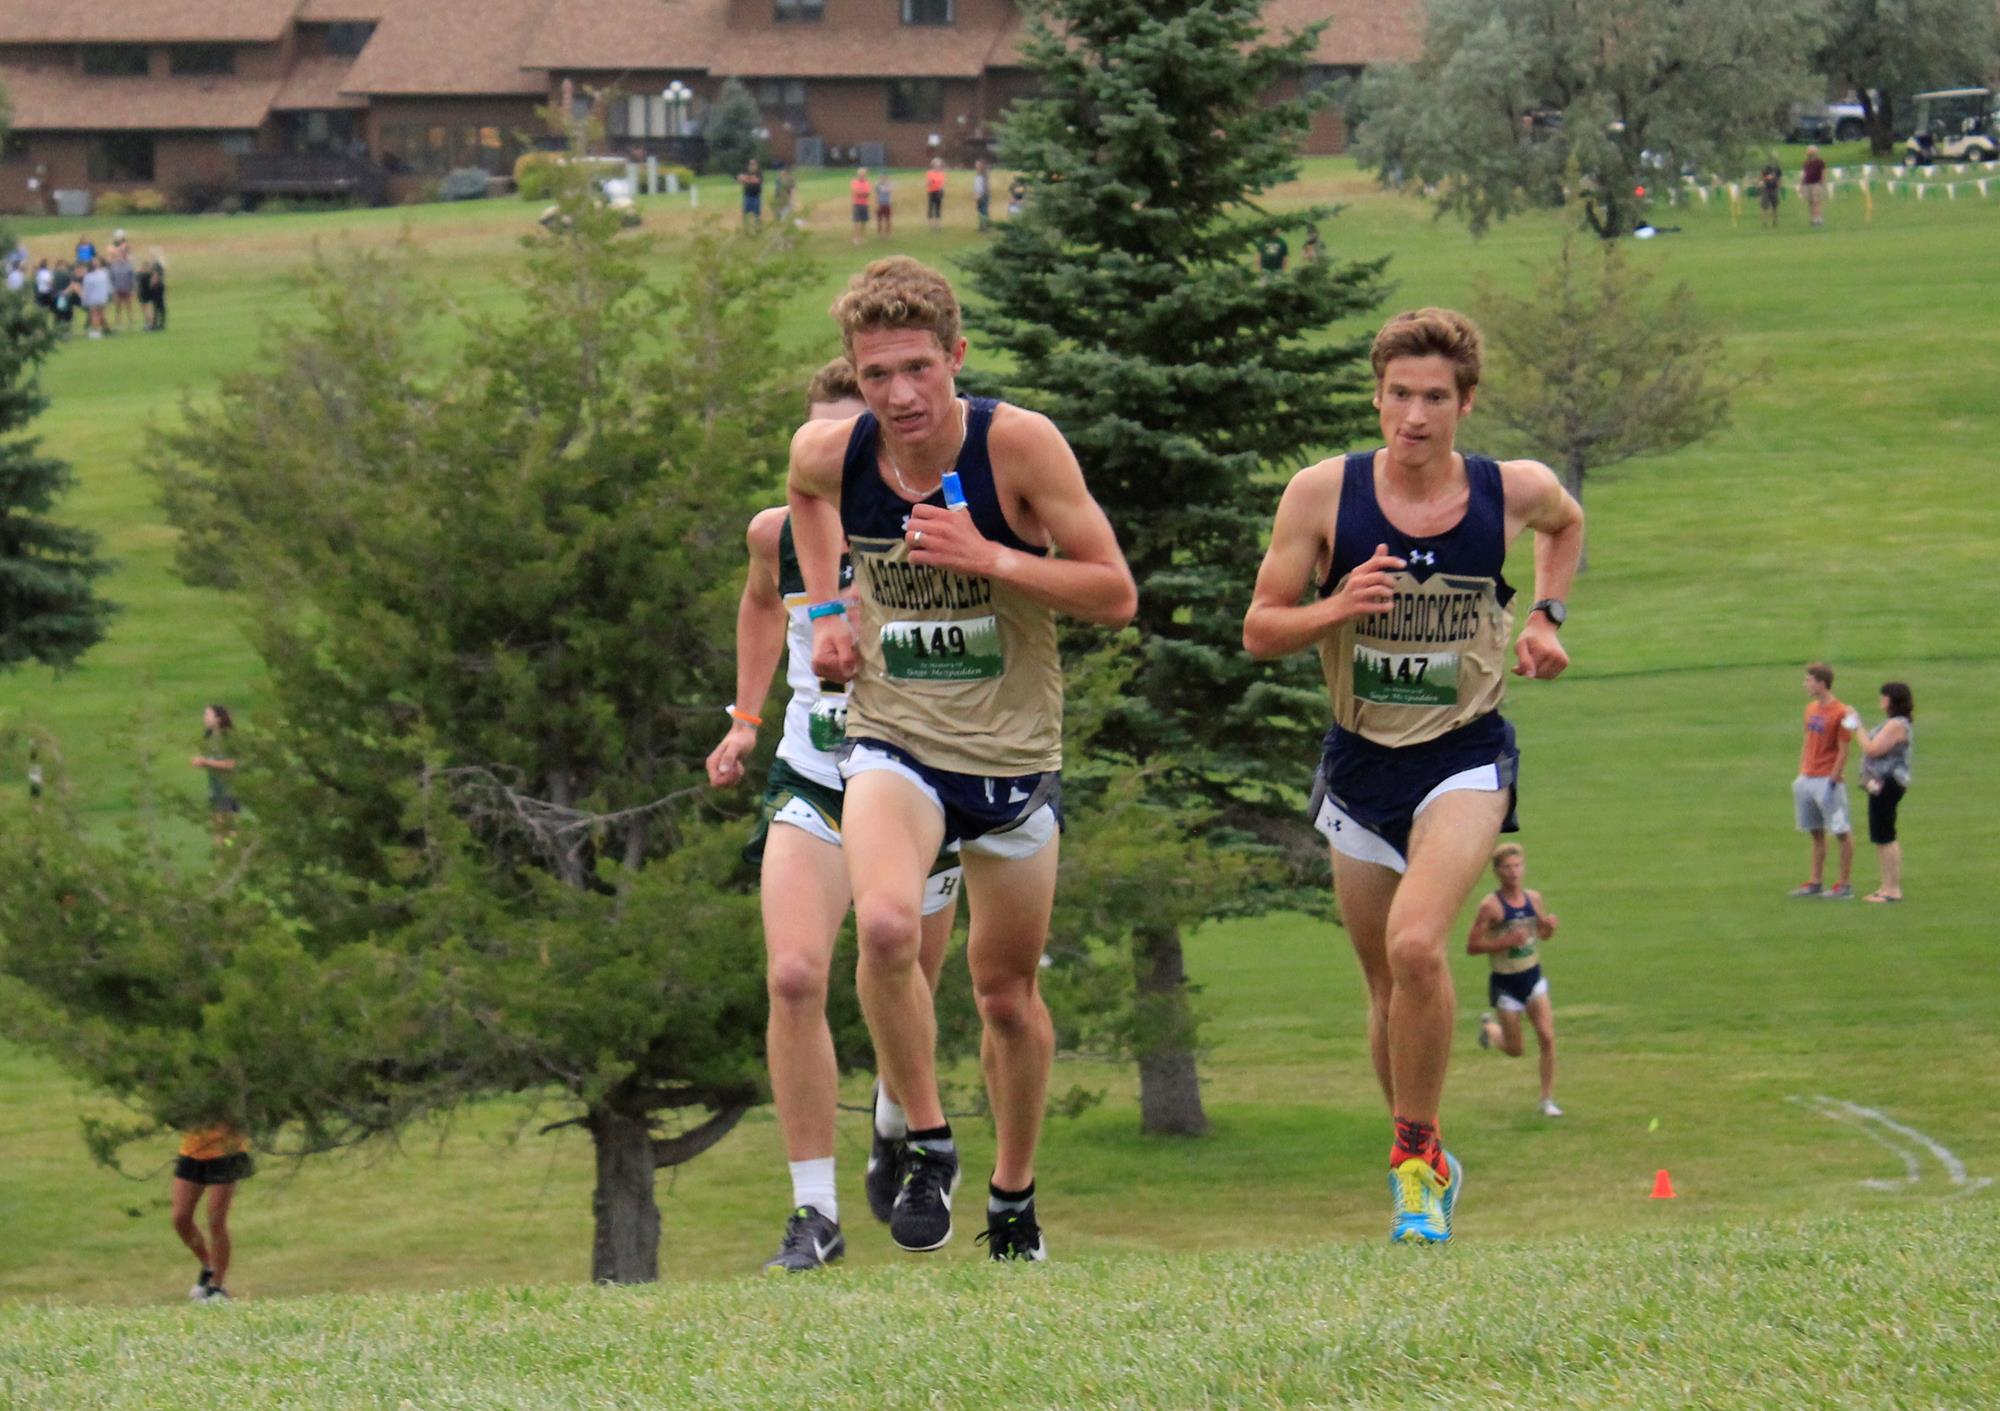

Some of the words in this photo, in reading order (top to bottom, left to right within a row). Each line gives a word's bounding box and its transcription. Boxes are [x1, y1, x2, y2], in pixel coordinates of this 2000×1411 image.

[866, 555, 991, 610] ARDROCKERS
[911, 626, 966, 658] 149
[1380, 657, 1429, 684] 147
